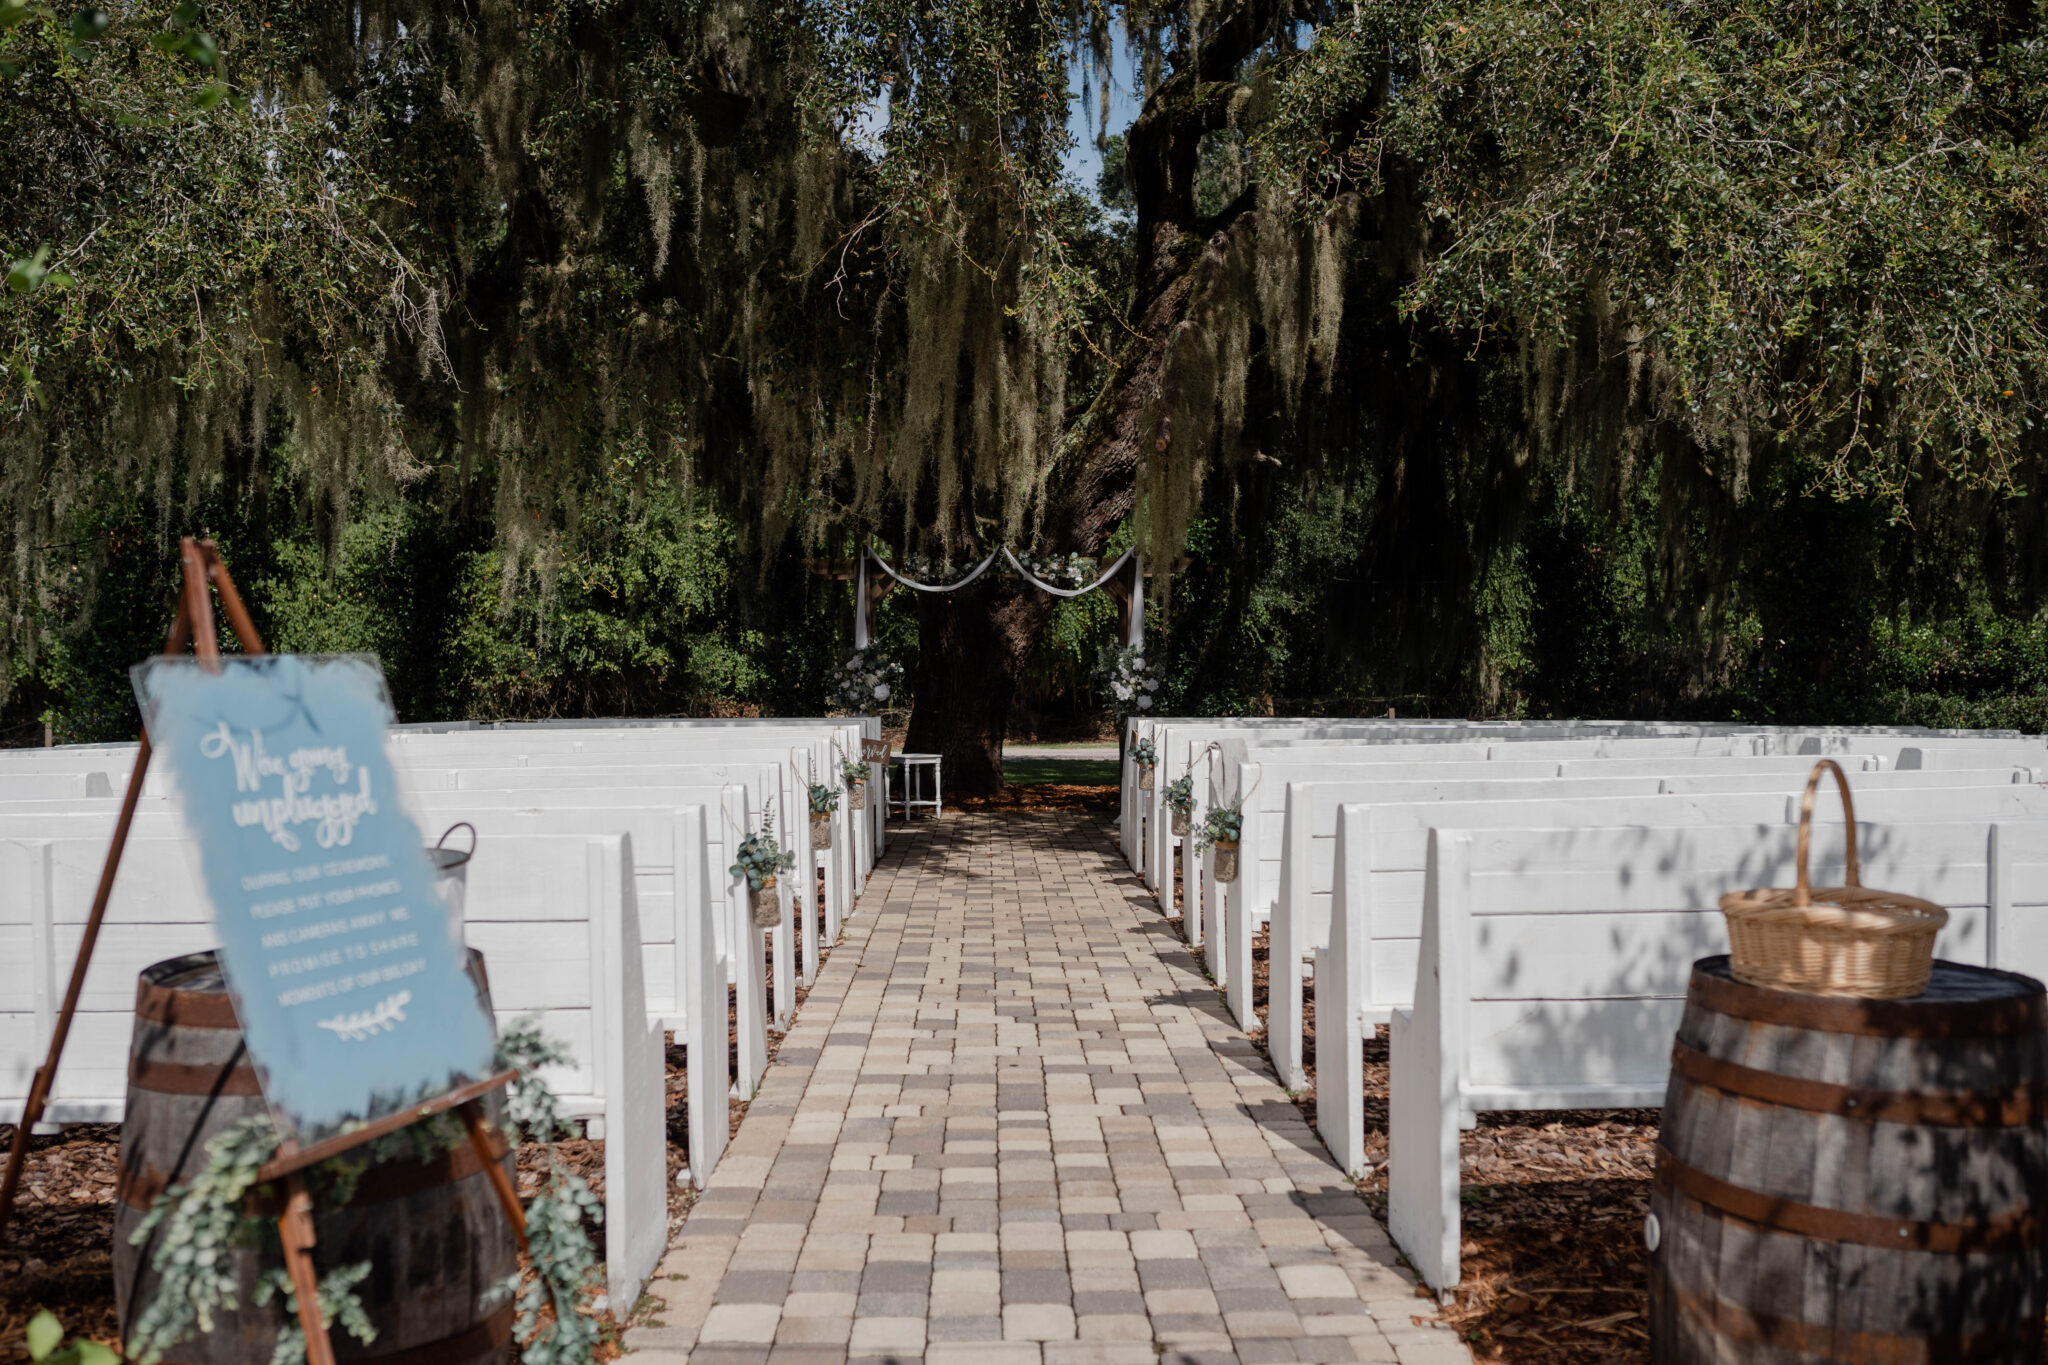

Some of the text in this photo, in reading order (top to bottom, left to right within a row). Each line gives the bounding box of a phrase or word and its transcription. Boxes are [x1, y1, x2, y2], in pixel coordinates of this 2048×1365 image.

[232, 765, 378, 852] unplugged
[241, 870, 291, 891] DURING
[292, 864, 321, 882] OUR
[250, 879, 400, 919] PLEASE PUT YOUR PHONES
[261, 931, 288, 948] AND
[288, 919, 348, 943] CAMERAS
[388, 905, 409, 921] WE
[268, 932, 418, 978] PROMISE TO SHARE
[278, 980, 338, 1006] MOMENTS
[337, 976, 355, 993] OF
[356, 970, 382, 988] OUR
